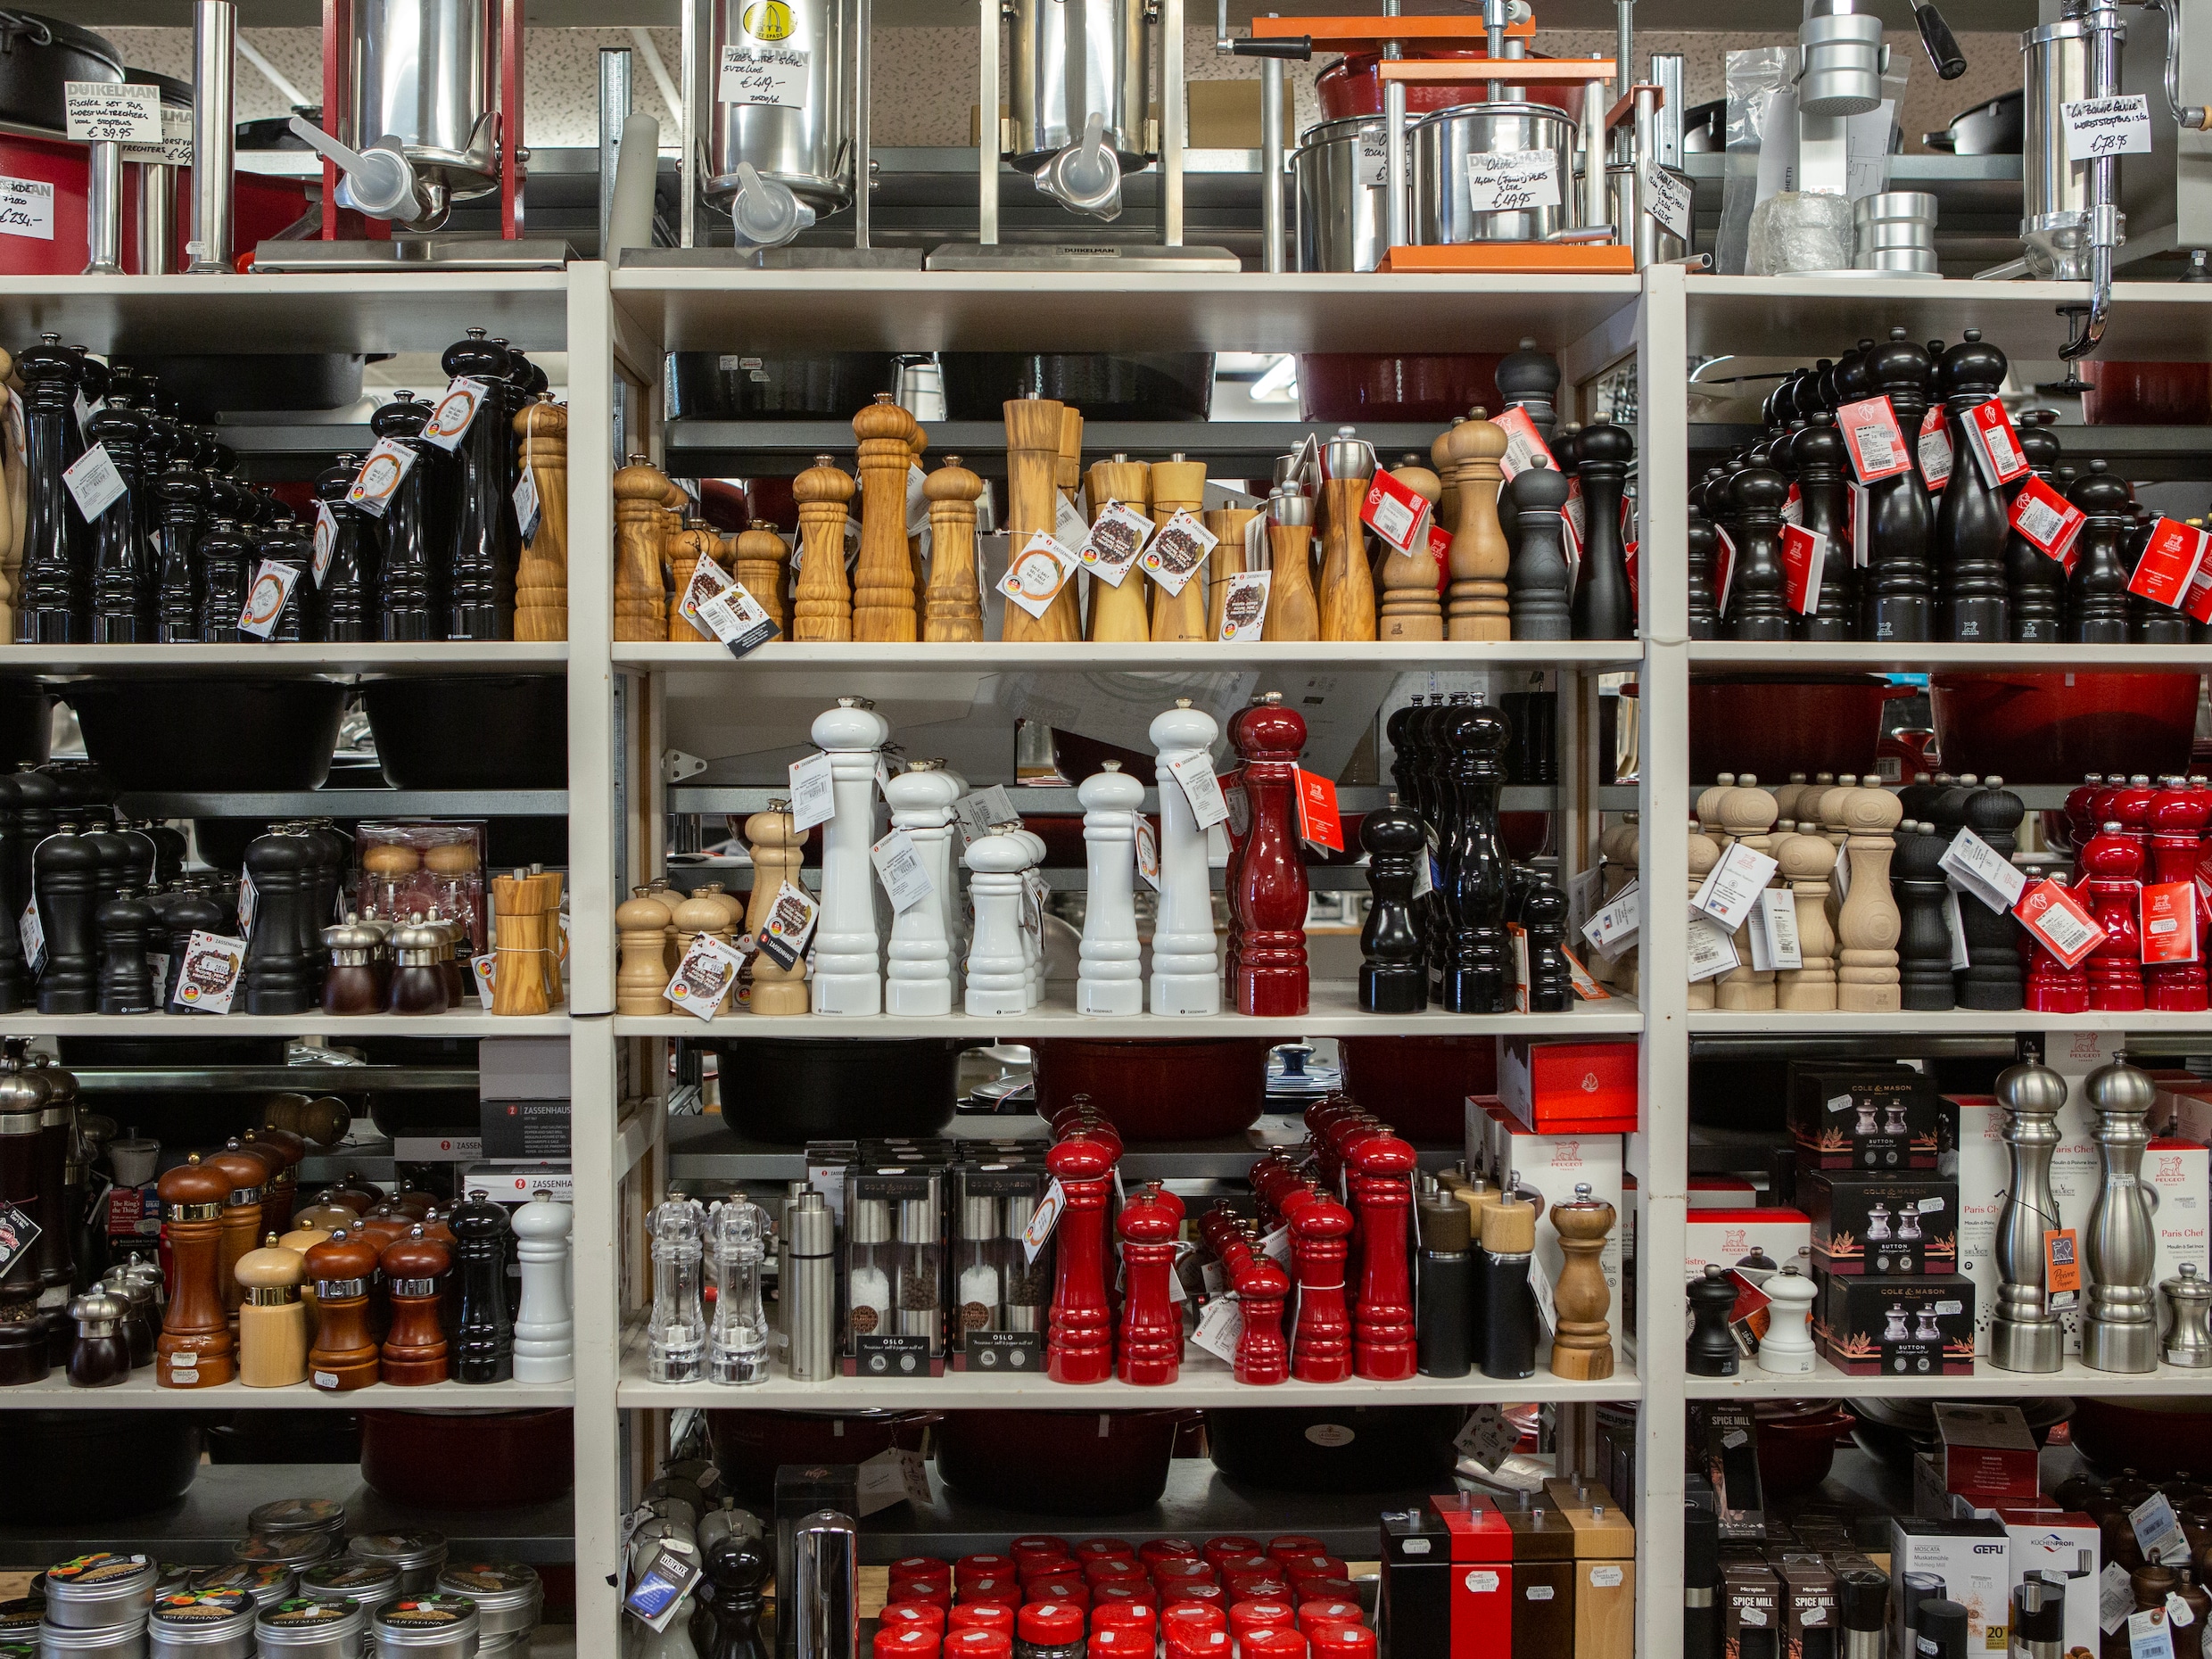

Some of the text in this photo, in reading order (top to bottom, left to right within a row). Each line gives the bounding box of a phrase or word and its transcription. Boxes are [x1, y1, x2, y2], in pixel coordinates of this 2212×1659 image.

[67, 83, 158, 99] DUIKELMAN
[75, 449, 96, 469] ZASSENHAUS
[1126, 511, 1151, 528] ZASSENHAUS
[1192, 524, 1214, 543] ZASSENHAUS
[1052, 544, 1077, 564] ZASSENHAUS
[801, 755, 823, 768] ZASSENHAUS
[879, 831, 899, 848] ZASSENHAUS
[214, 938, 243, 949] ZASSENHAUS
[716, 945, 741, 962] ZASSENHAUS
[769, 939, 795, 963] ZASSENHAUS
[524, 1106, 571, 1114] ZASSENHAUS
[2056, 1144, 2094, 1153] aris Chef
[532, 1180, 572, 1188] ZASSENHA
[123, 1200, 140, 1208] Ring's
[1963, 1205, 1983, 1214] Paris
[2161, 1228, 2204, 1237] Paris Chef
[2053, 1268, 2076, 1280] Poivre
[2056, 1280, 2073, 1288] Pepper
[1904, 1287, 1914, 1295] &
[1201, 1307, 1220, 1330] ZASSENHAUS
[1741, 1330, 1754, 1345] 1840
[1597, 1411, 1635, 1426] CREUSET
[1712, 1416, 1750, 1425] SPICE MILL
[2030, 1539, 2075, 1547] KÜCHENPROFI
[1973, 1545, 2003, 1555] GEFU
[661, 1556, 687, 1576] marlux
[1914, 1561, 1935, 1569] Nutmeg
[85, 1566, 145, 1583] WARTMANN
[1732, 1597, 1773, 1606] SPICE MILL
[1795, 1597, 1835, 1606] SPICE MILL
